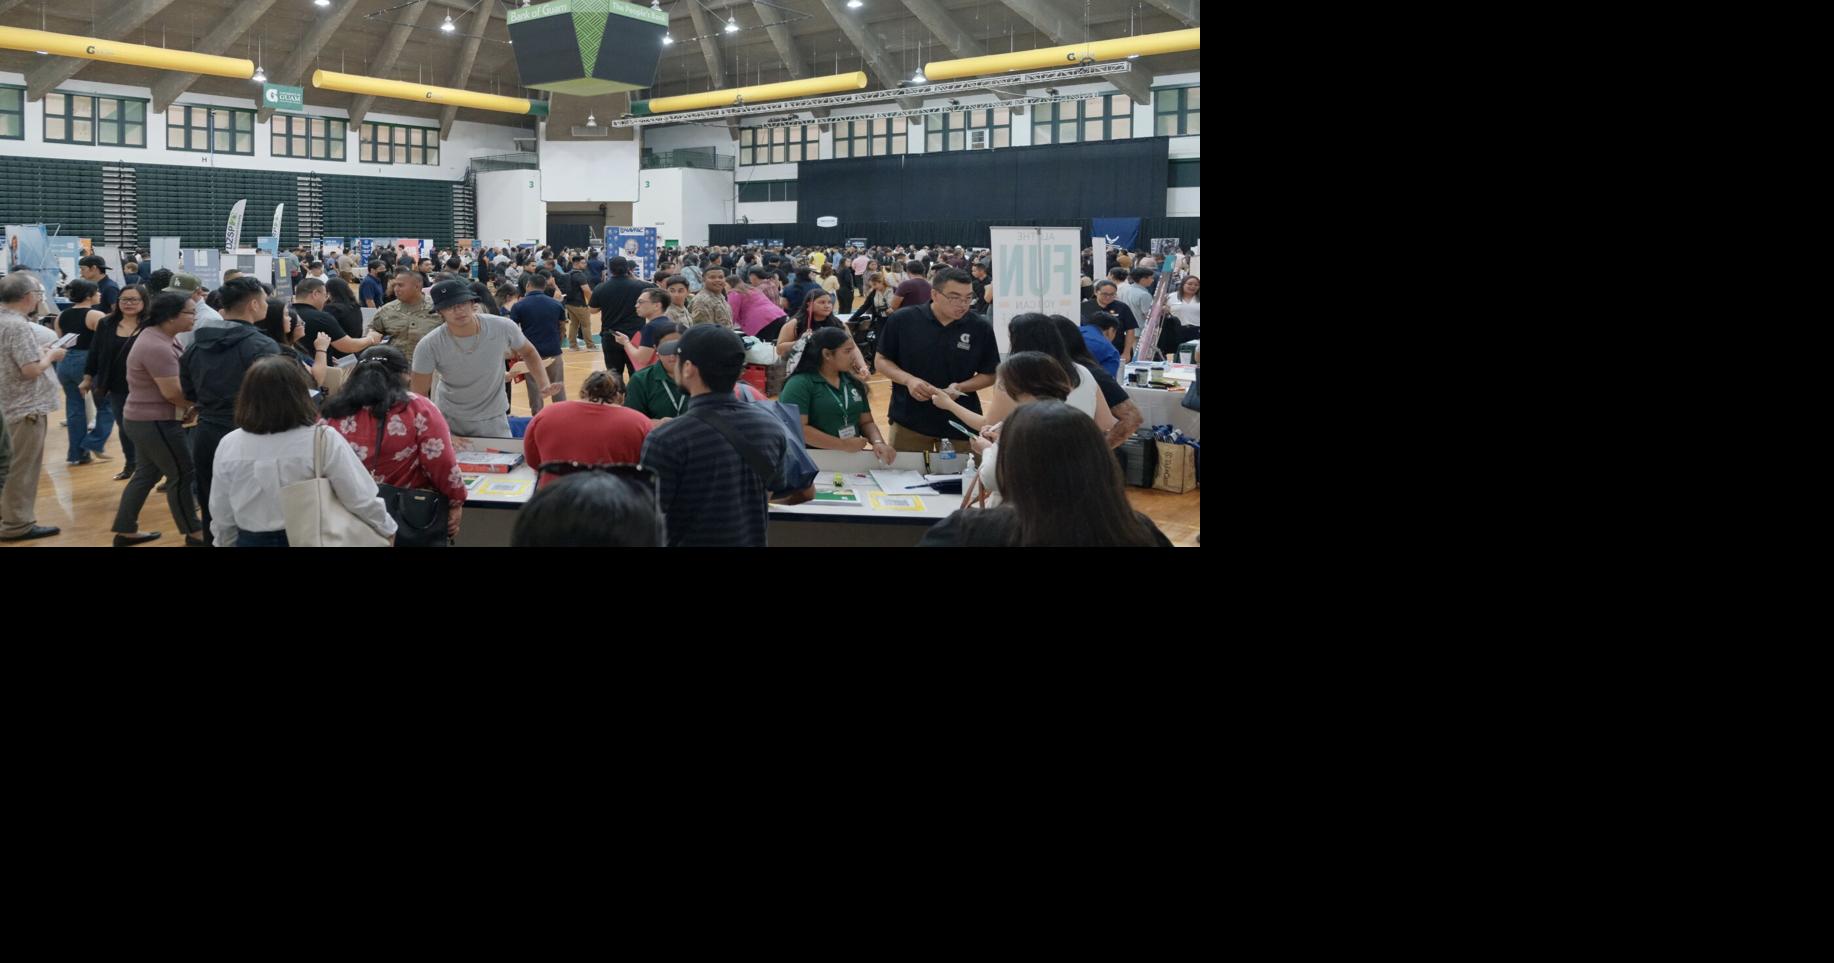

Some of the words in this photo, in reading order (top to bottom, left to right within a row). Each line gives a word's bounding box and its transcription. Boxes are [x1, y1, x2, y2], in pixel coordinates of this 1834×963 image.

[511, 10, 530, 22] Bank
[531, 7, 541, 18] of
[543, 4, 567, 16] Guam
[279, 94, 302, 102] GUAM
[529, 180, 534, 188] 3
[645, 180, 650, 188] 3
